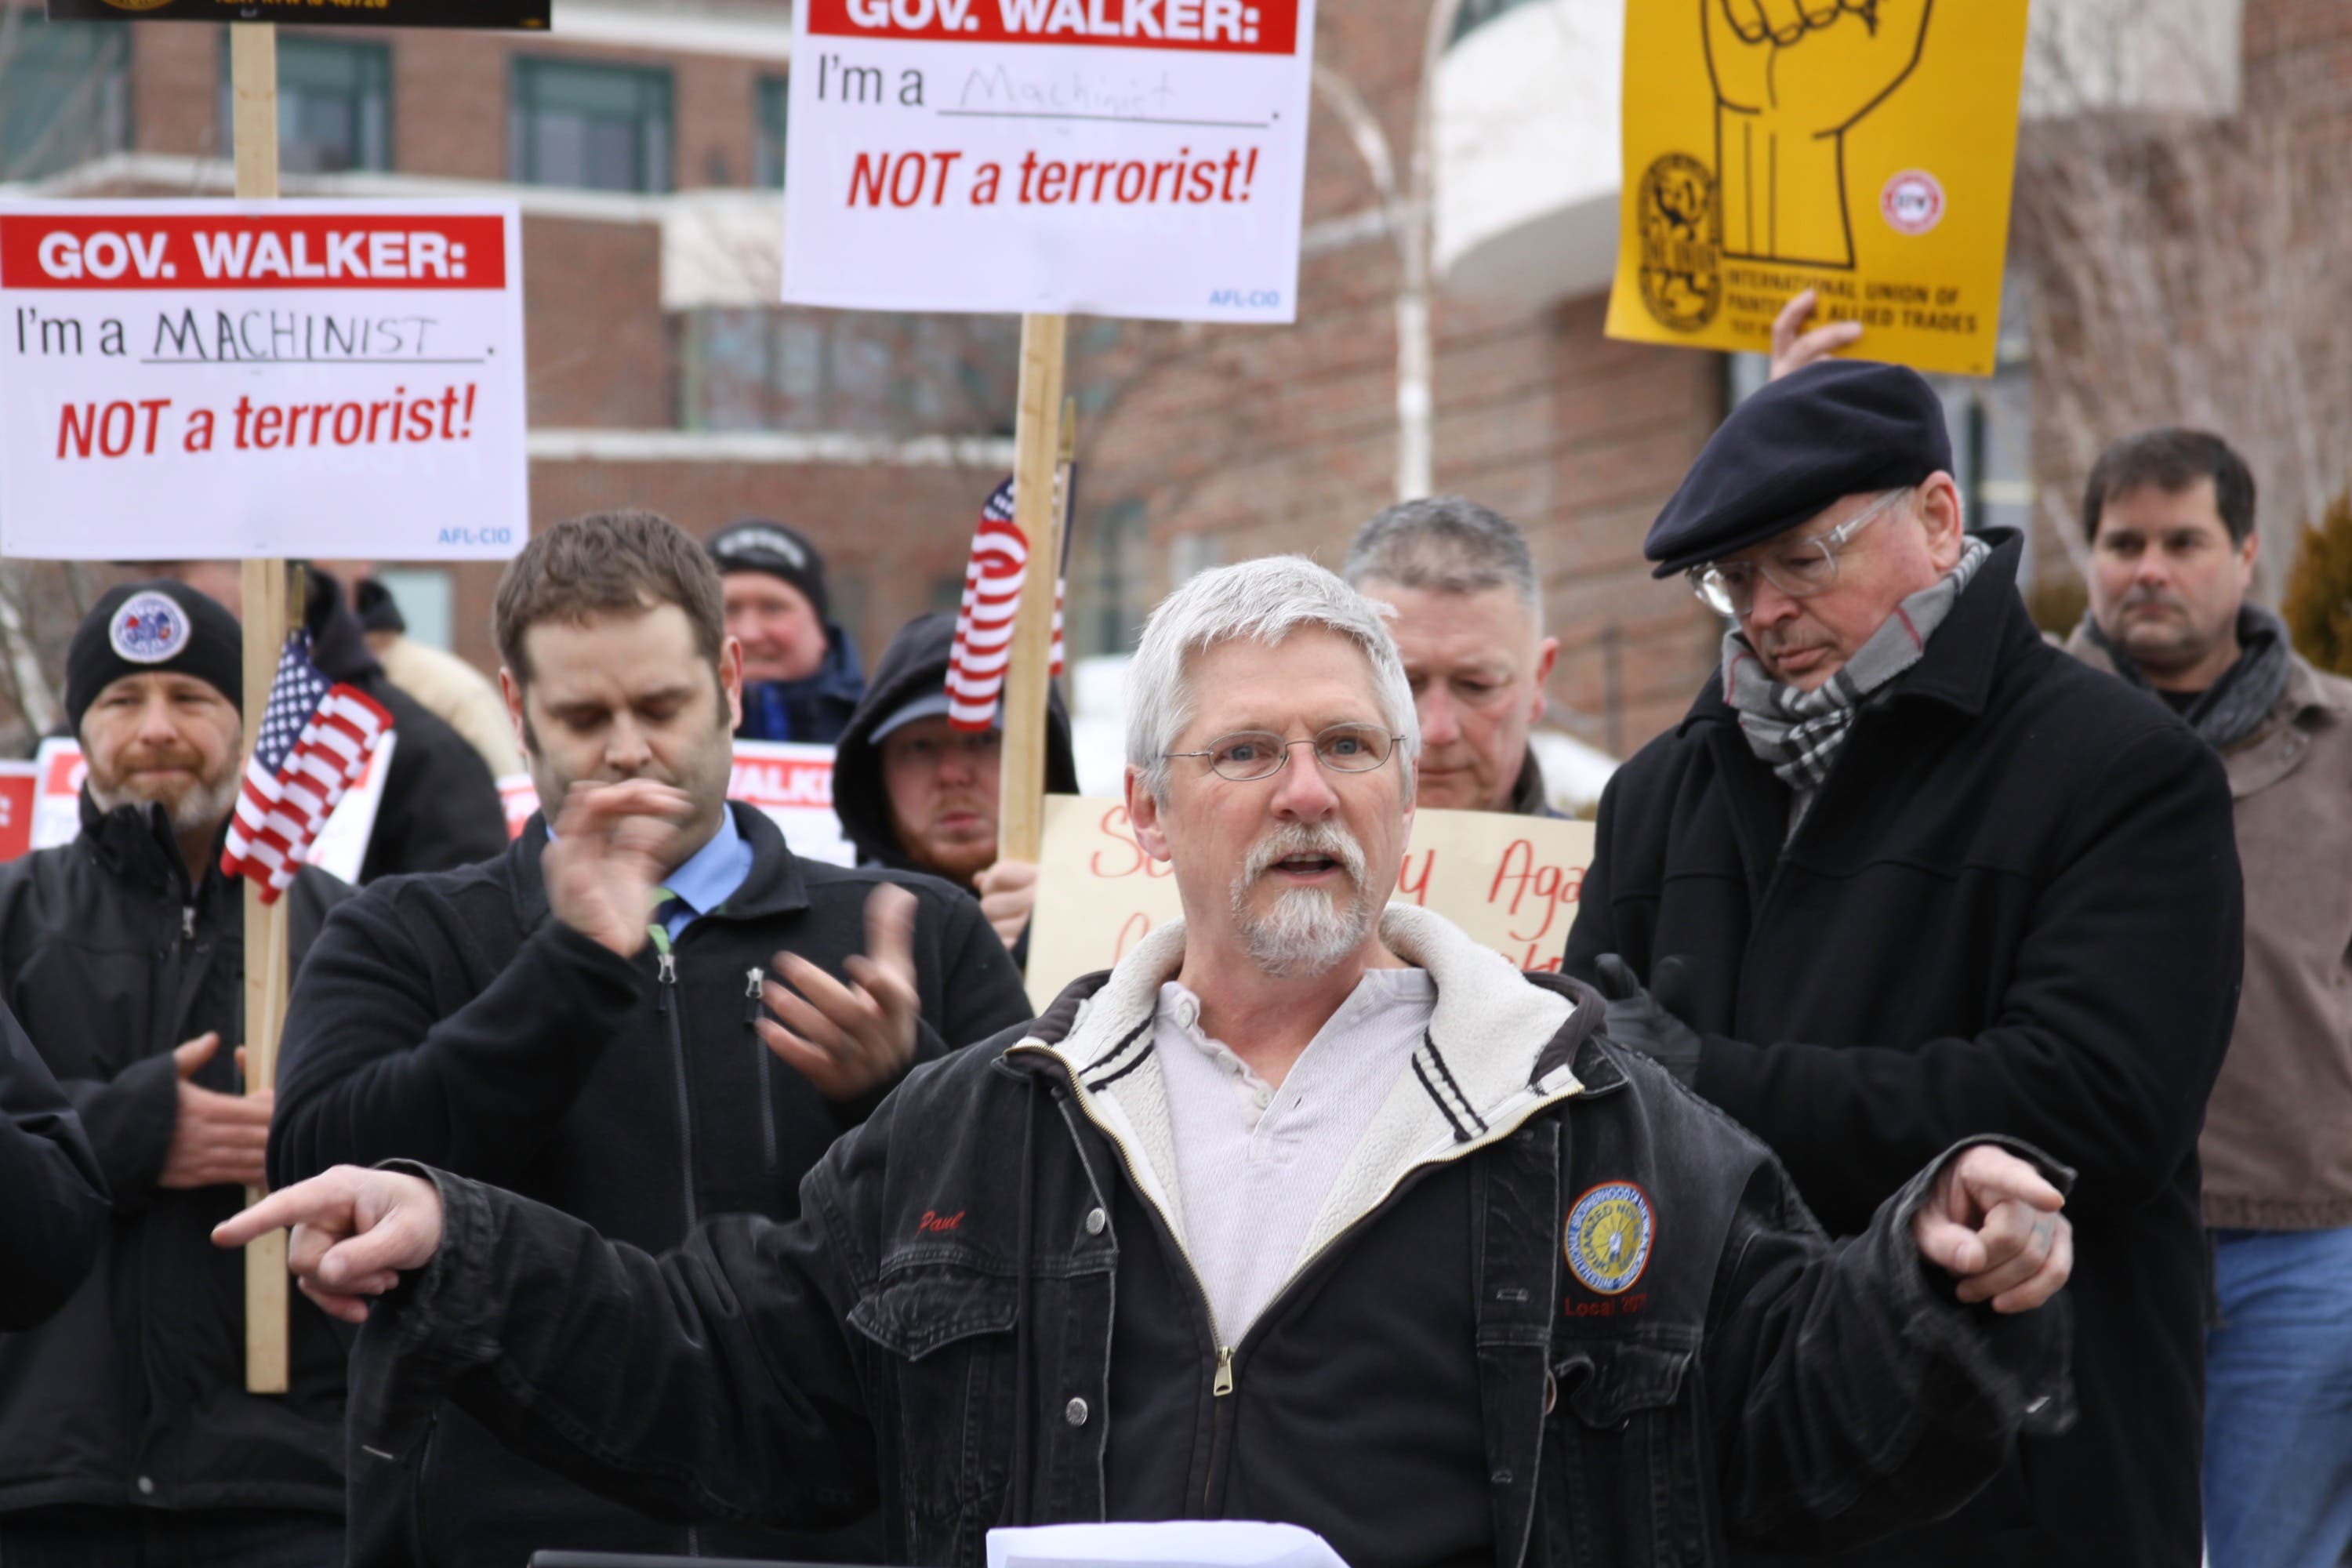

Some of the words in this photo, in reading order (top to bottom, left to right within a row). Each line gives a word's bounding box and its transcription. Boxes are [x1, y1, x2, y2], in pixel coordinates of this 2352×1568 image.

[846, 0, 978, 32] GOV.
[1000, 0, 1261, 43] WALKER:
[818, 53, 884, 103] I'm
[898, 70, 924, 106] a
[847, 151, 961, 208] NOT
[971, 163, 1002, 205] a
[1018, 148, 1258, 204] terrorist!
[38, 231, 177, 280] GOV.
[193, 231, 466, 279] WALKER:
[1208, 290, 1280, 309] AFL-CIO
[16, 307, 83, 355] I'm
[100, 318, 127, 357] a
[153, 307, 440, 362] MACHINIST
[56, 399, 172, 459] NOT
[183, 409, 214, 453] a
[233, 383, 477, 449] terrorist!
[437, 527, 514, 545] AFL-CIO
[916, 1210, 966, 1236] Paul
[1565, 1296, 1616, 1316] Local
